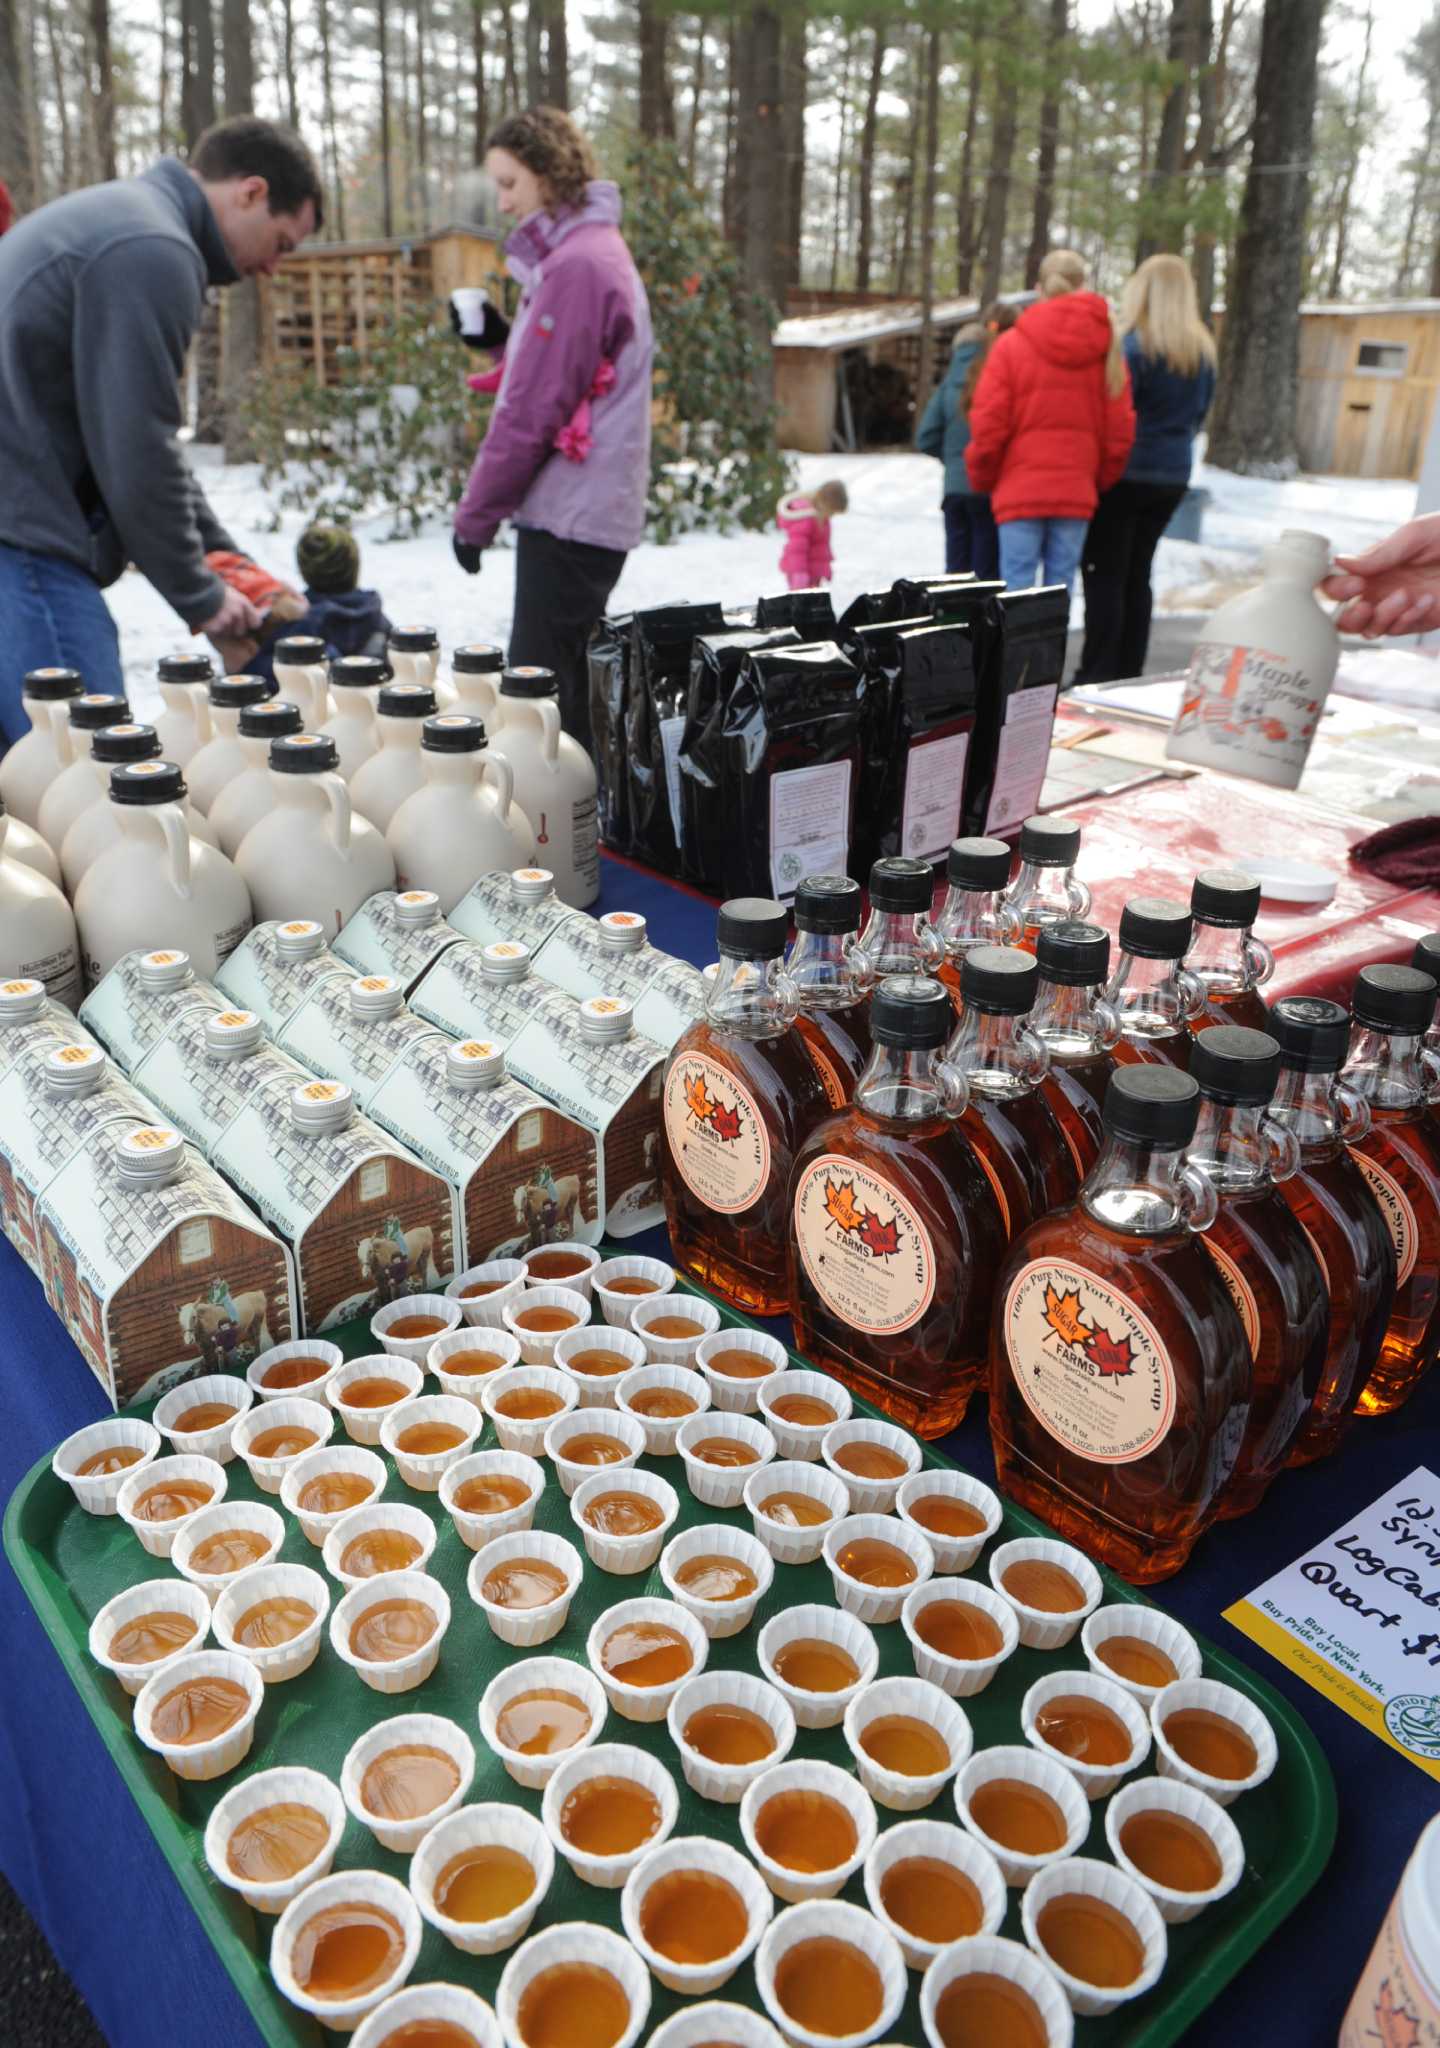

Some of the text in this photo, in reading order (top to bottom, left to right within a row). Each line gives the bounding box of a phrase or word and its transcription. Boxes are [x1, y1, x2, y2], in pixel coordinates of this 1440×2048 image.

[1246, 659, 1311, 690] Maple
[694, 1120, 720, 1144] FARMS
[706, 1067, 727, 1086] York
[727, 1082, 753, 1119] Maple
[750, 1120, 762, 1165] Syrup
[813, 1167, 832, 1182] Pure
[831, 1164, 852, 1177] New
[855, 1171, 882, 1196] York
[883, 1192, 915, 1232] Maple
[911, 1234, 925, 1284] Syrup
[830, 1194, 854, 1222] SUGAR
[1365, 1169, 1405, 1259] Maple Syrup
[836, 1231, 870, 1257] FARMS
[1050, 1303, 1079, 1337] SUGAR
[1013, 1285, 1031, 1320] 100%
[1030, 1271, 1053, 1287] Pure
[1054, 1268, 1078, 1285] New
[1083, 1279, 1114, 1309] York
[1117, 1305, 1152, 1354] Maple
[1148, 1355, 1162, 1411] Syrup
[1055, 1343, 1097, 1377] FARMS
[1054, 1410, 1071, 1427] 12.5
[1300, 1561, 1402, 1628] Quart
[1261, 1599, 1387, 1697] Buy Pride of New York.
[1303, 1616, 1361, 1663] Buy Local.
[1292, 1648, 1313, 1664] Our
[1311, 1661, 1337, 1685] Pride
[1392, 1697, 1427, 1711] PRIDE
[1389, 1721, 1416, 1746] NEW
